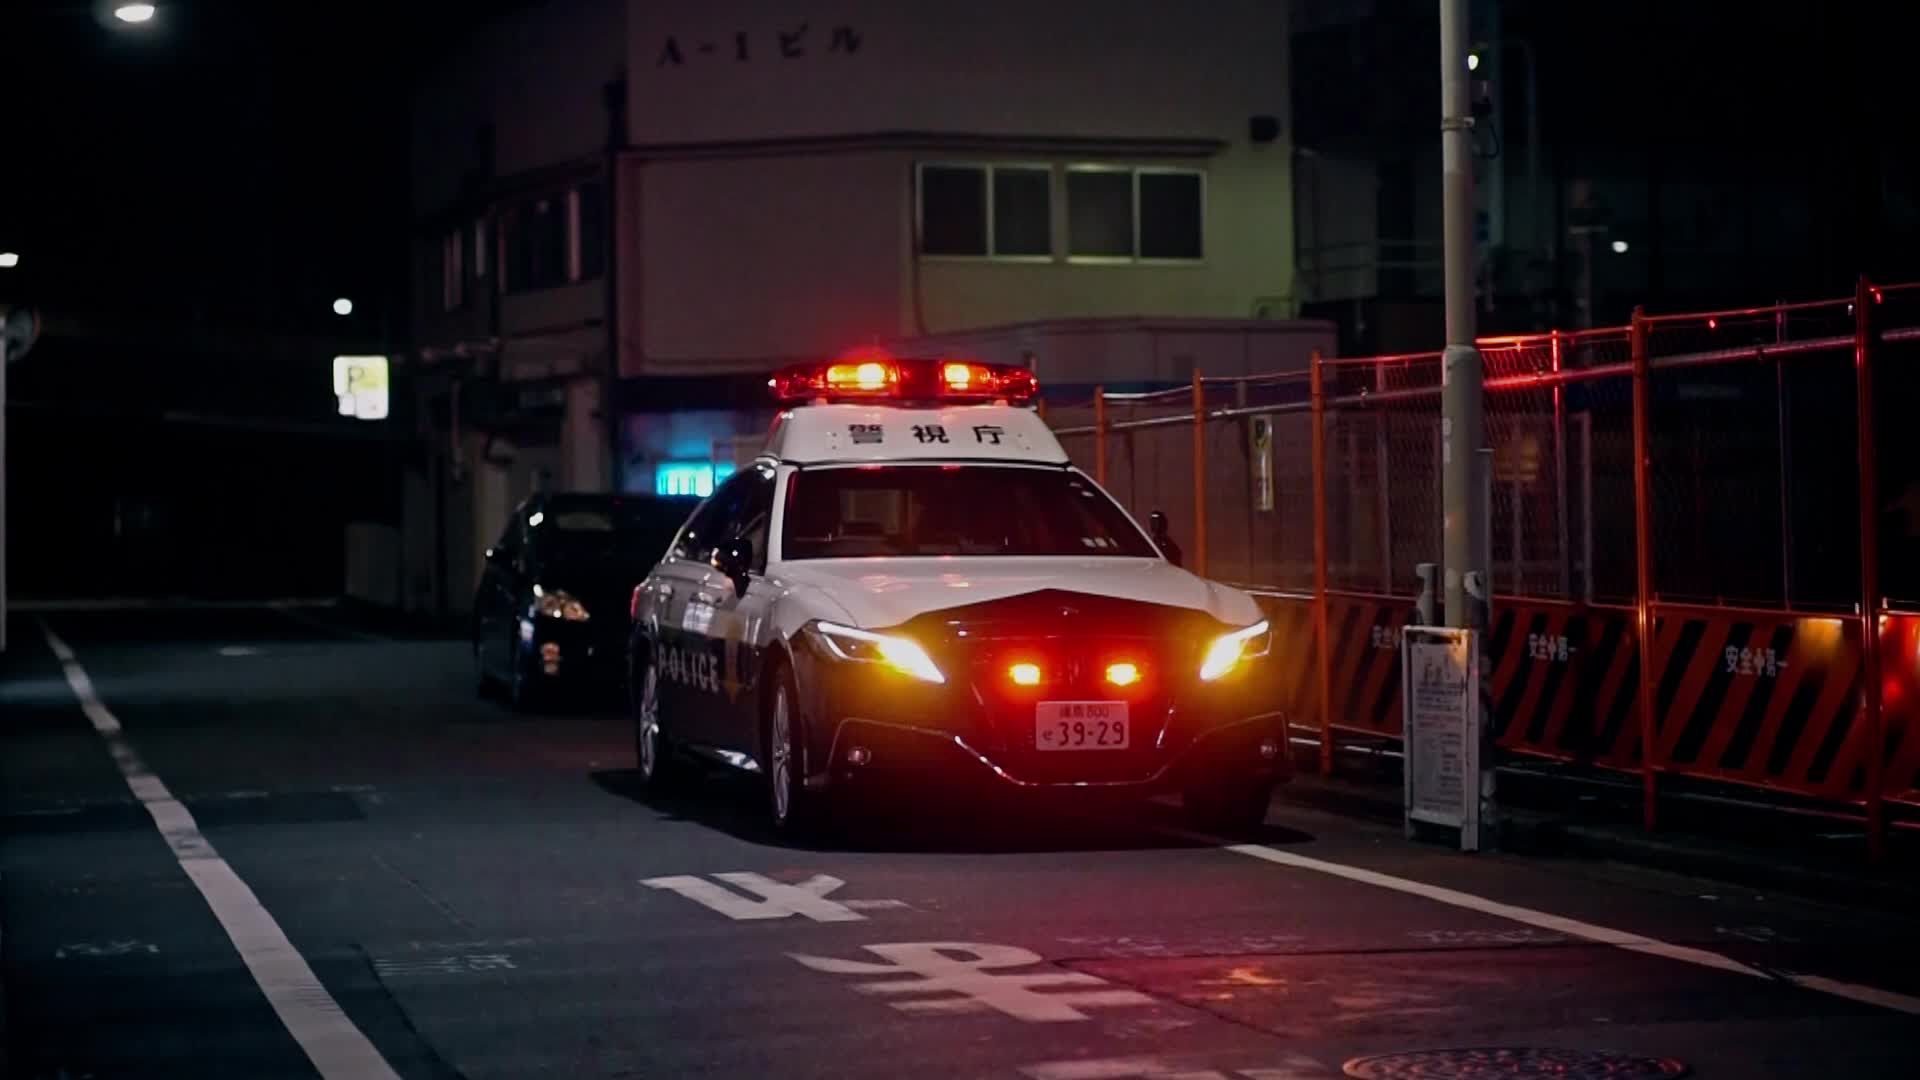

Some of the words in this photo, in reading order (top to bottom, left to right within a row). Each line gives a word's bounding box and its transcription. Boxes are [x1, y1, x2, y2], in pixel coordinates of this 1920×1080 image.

[848, 424, 1004, 445] 警視庁
[658, 641, 719, 693] POLICE
[1058, 721, 1124, 746] 39-29
